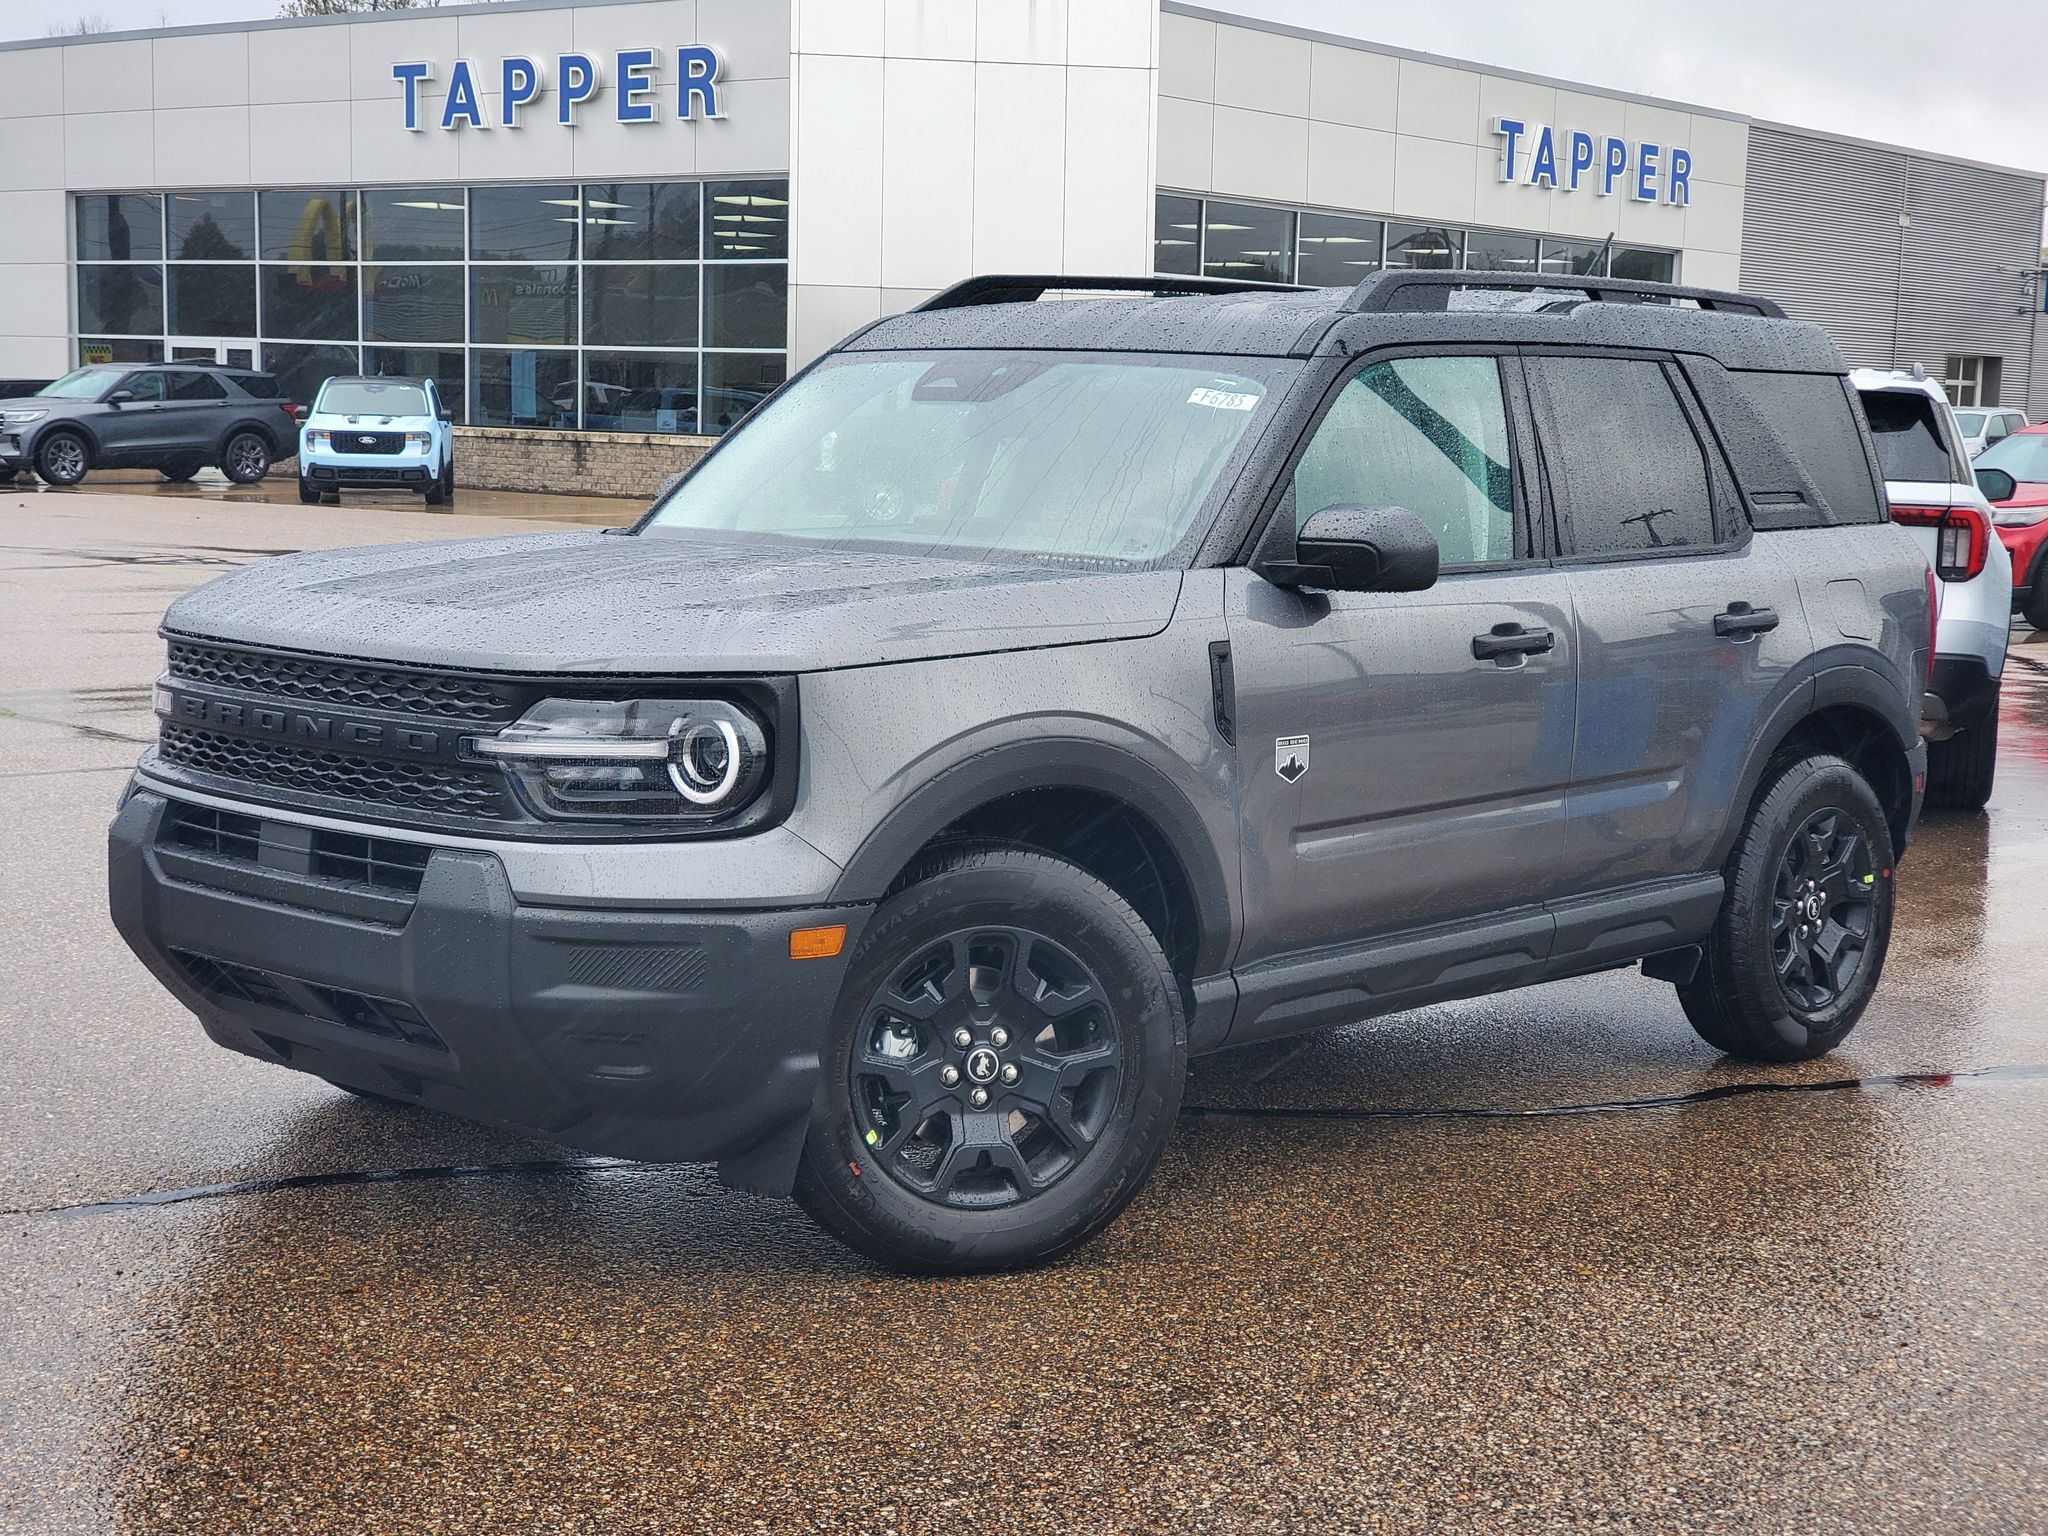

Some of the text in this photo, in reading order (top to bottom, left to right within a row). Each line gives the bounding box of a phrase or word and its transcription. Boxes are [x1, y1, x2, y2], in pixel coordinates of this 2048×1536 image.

[391, 44, 725, 132] TAPPER
[1494, 116, 1692, 207] TAPPER
[180, 695, 439, 752] BRONCO
